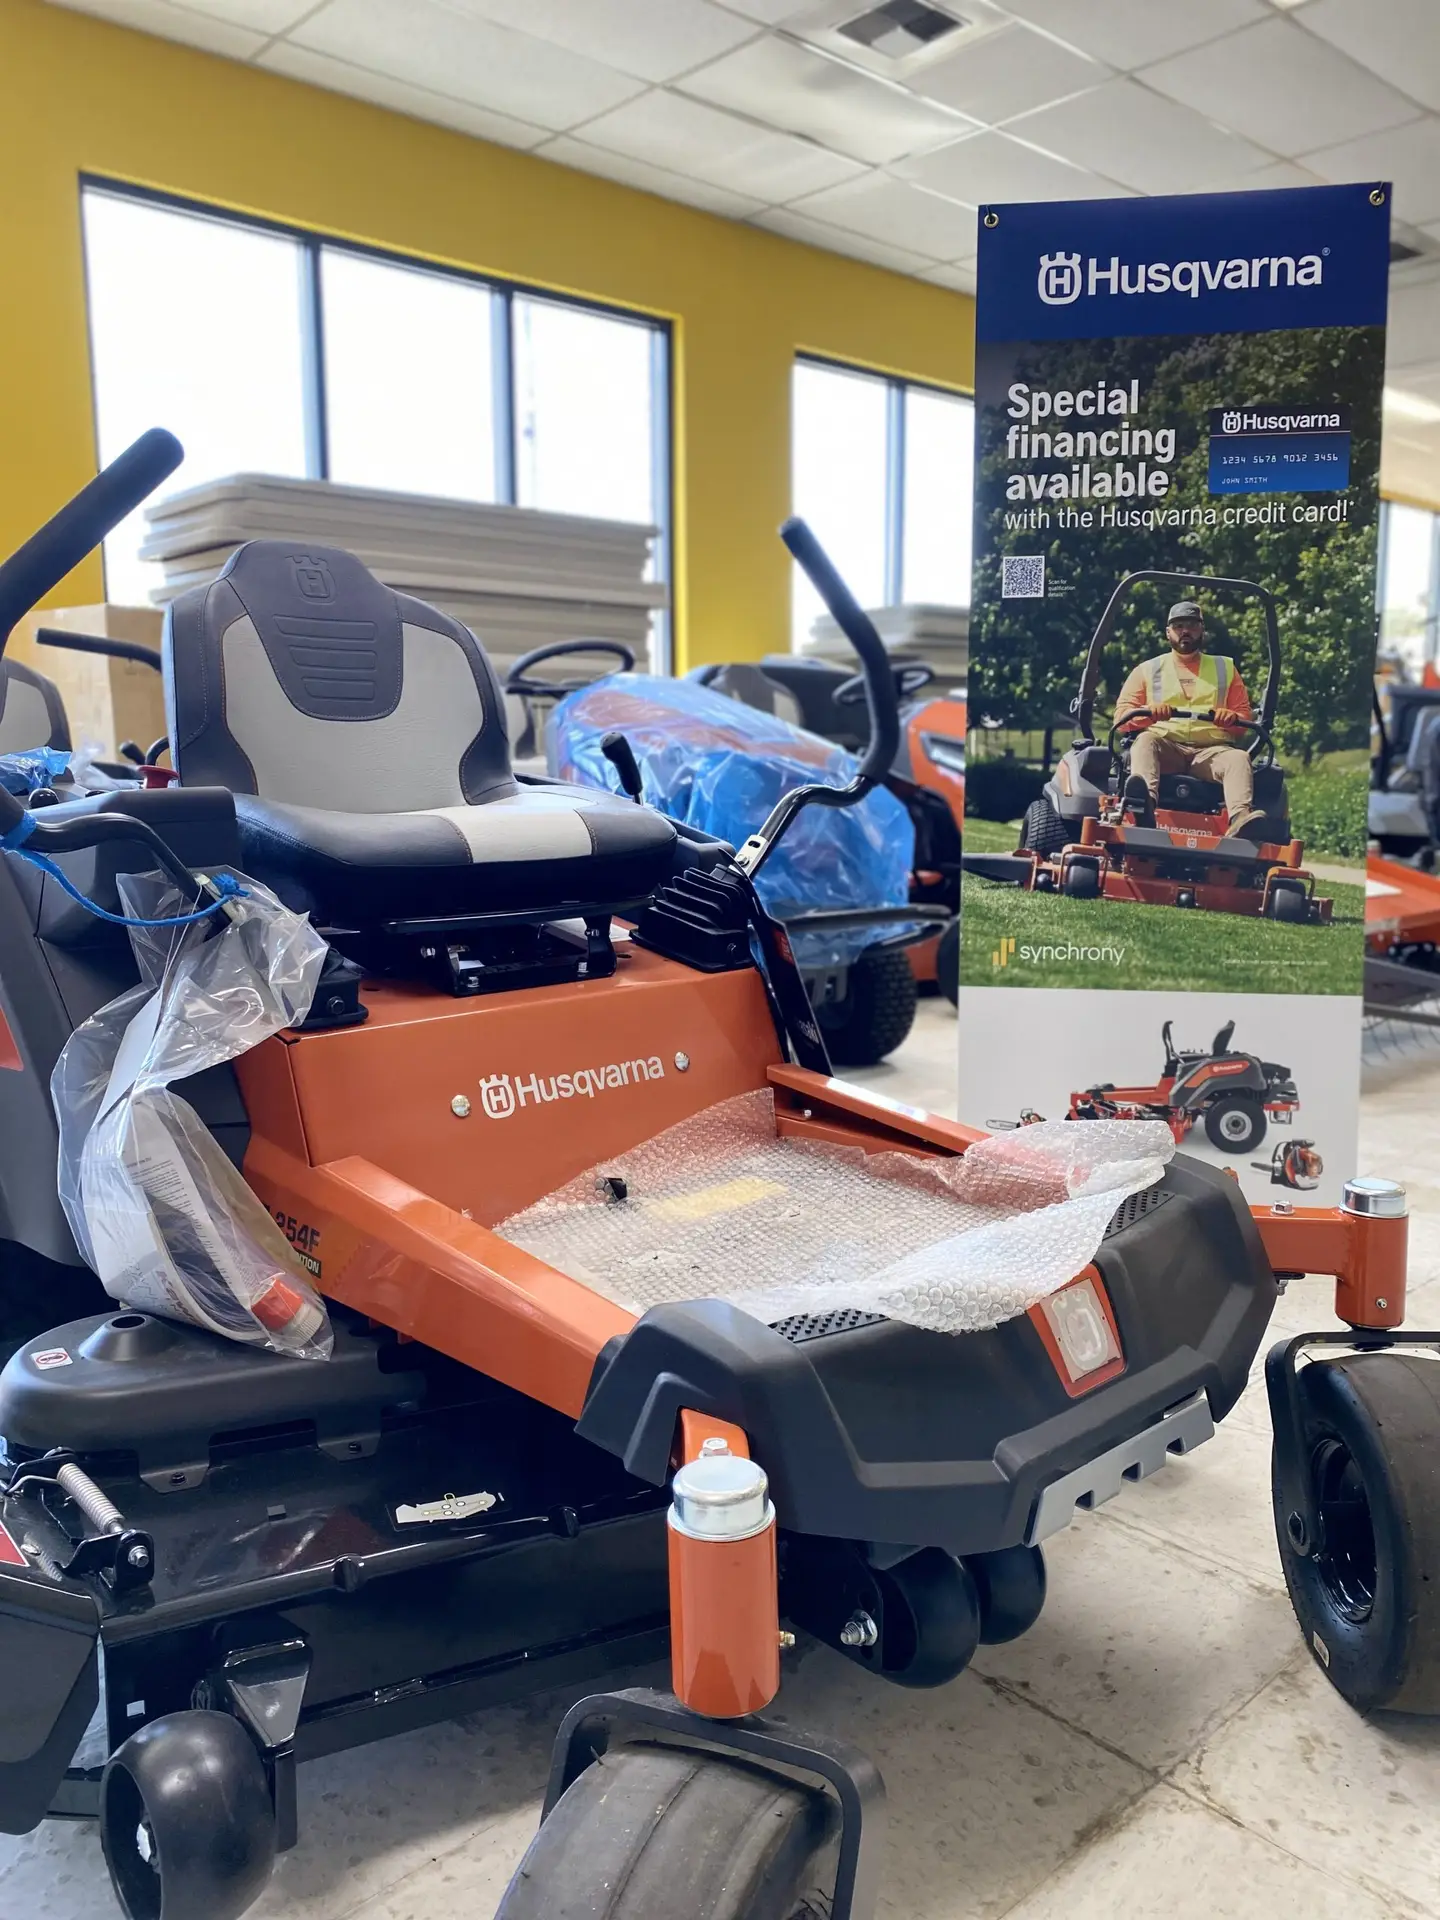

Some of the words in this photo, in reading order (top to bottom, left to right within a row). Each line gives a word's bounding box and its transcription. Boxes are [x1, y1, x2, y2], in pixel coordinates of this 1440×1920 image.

[1007, 379, 1139, 425] Special
[1243, 413, 1340, 431] Husqvarna
[1006, 421, 1176, 463] financing
[1222, 456, 1246, 465] 1234
[1253, 455, 1277, 464] 5678
[1283, 454, 1308, 463] 9012
[1314, 453, 1339, 462] 3456
[1006, 462, 1169, 500] available
[1005, 507, 1050, 529] with
[1058, 507, 1094, 528] the
[1100, 504, 1215, 532] Husqvarna
[1223, 502, 1286, 525] credit
[1020, 942, 1125, 966] synchrony
[514, 1056, 665, 1108] Husqvarna
